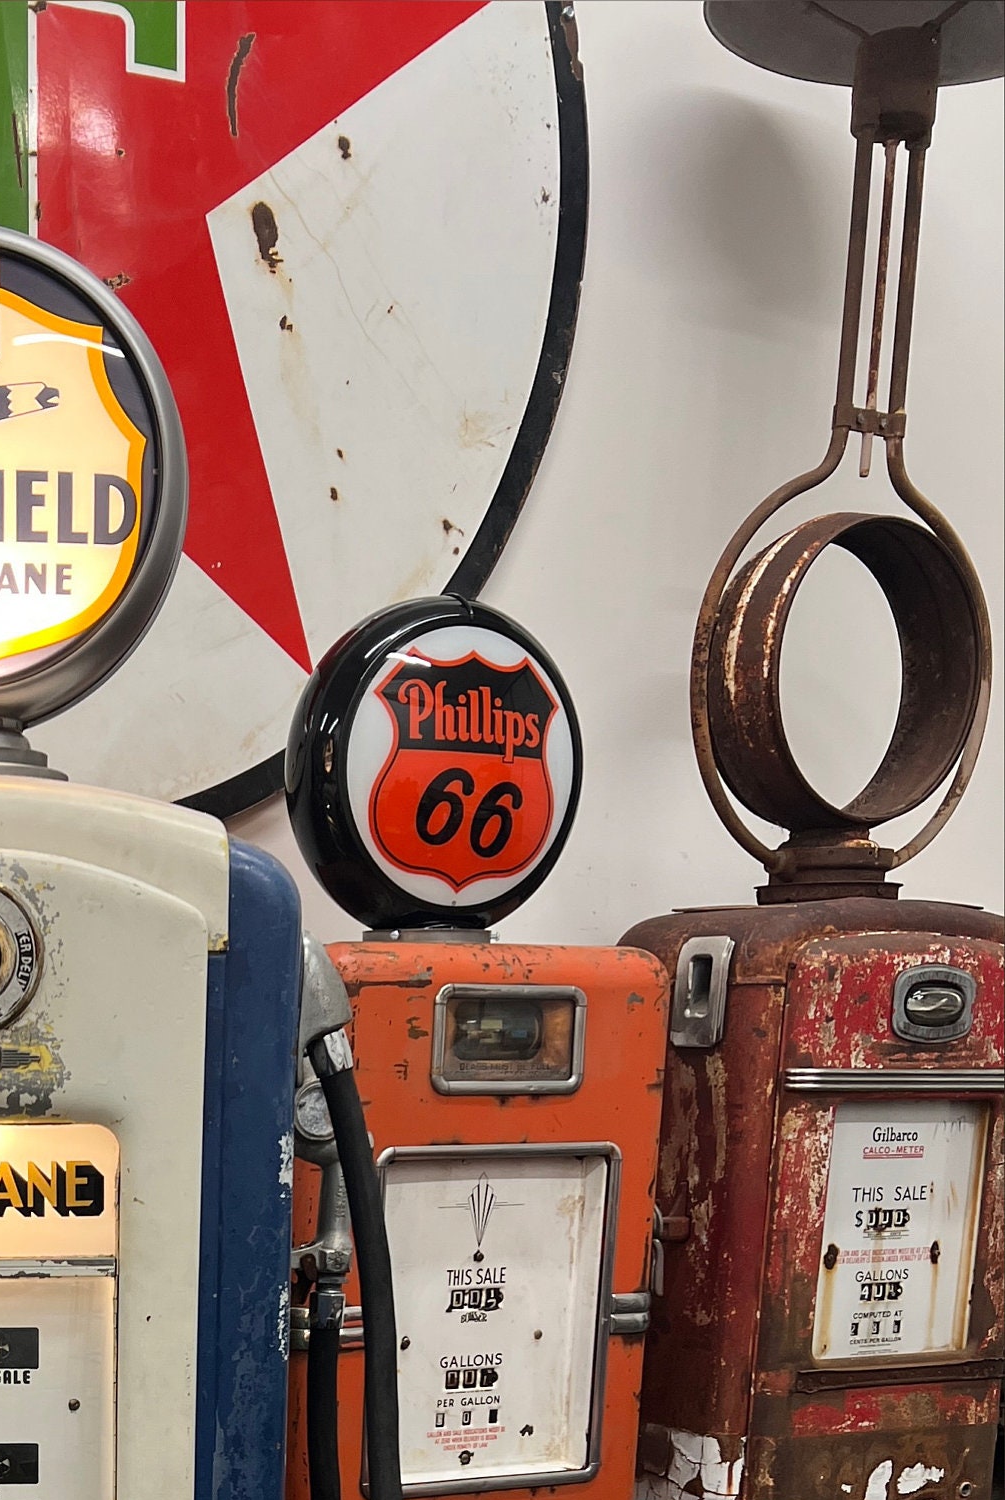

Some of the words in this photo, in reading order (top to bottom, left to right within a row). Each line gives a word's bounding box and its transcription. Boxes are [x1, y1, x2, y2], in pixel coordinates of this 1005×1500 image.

[398, 678, 540, 764] Phillips
[415, 768, 523, 859] 66
[873, 1127, 918, 1142] Gilbarco
[852, 1187, 884, 1202] THIS
[894, 1185, 927, 1200] SALE
[447, 1269, 473, 1286] THIS
[476, 1267, 507, 1285] SALE
[855, 1269, 909, 1282] GALLONS
[853, 1311, 891, 1319] COMPUTED
[440, 1353, 503, 1369] GALLONS
[437, 1398, 455, 1407] PER
[461, 1395, 501, 1406] GALLON
